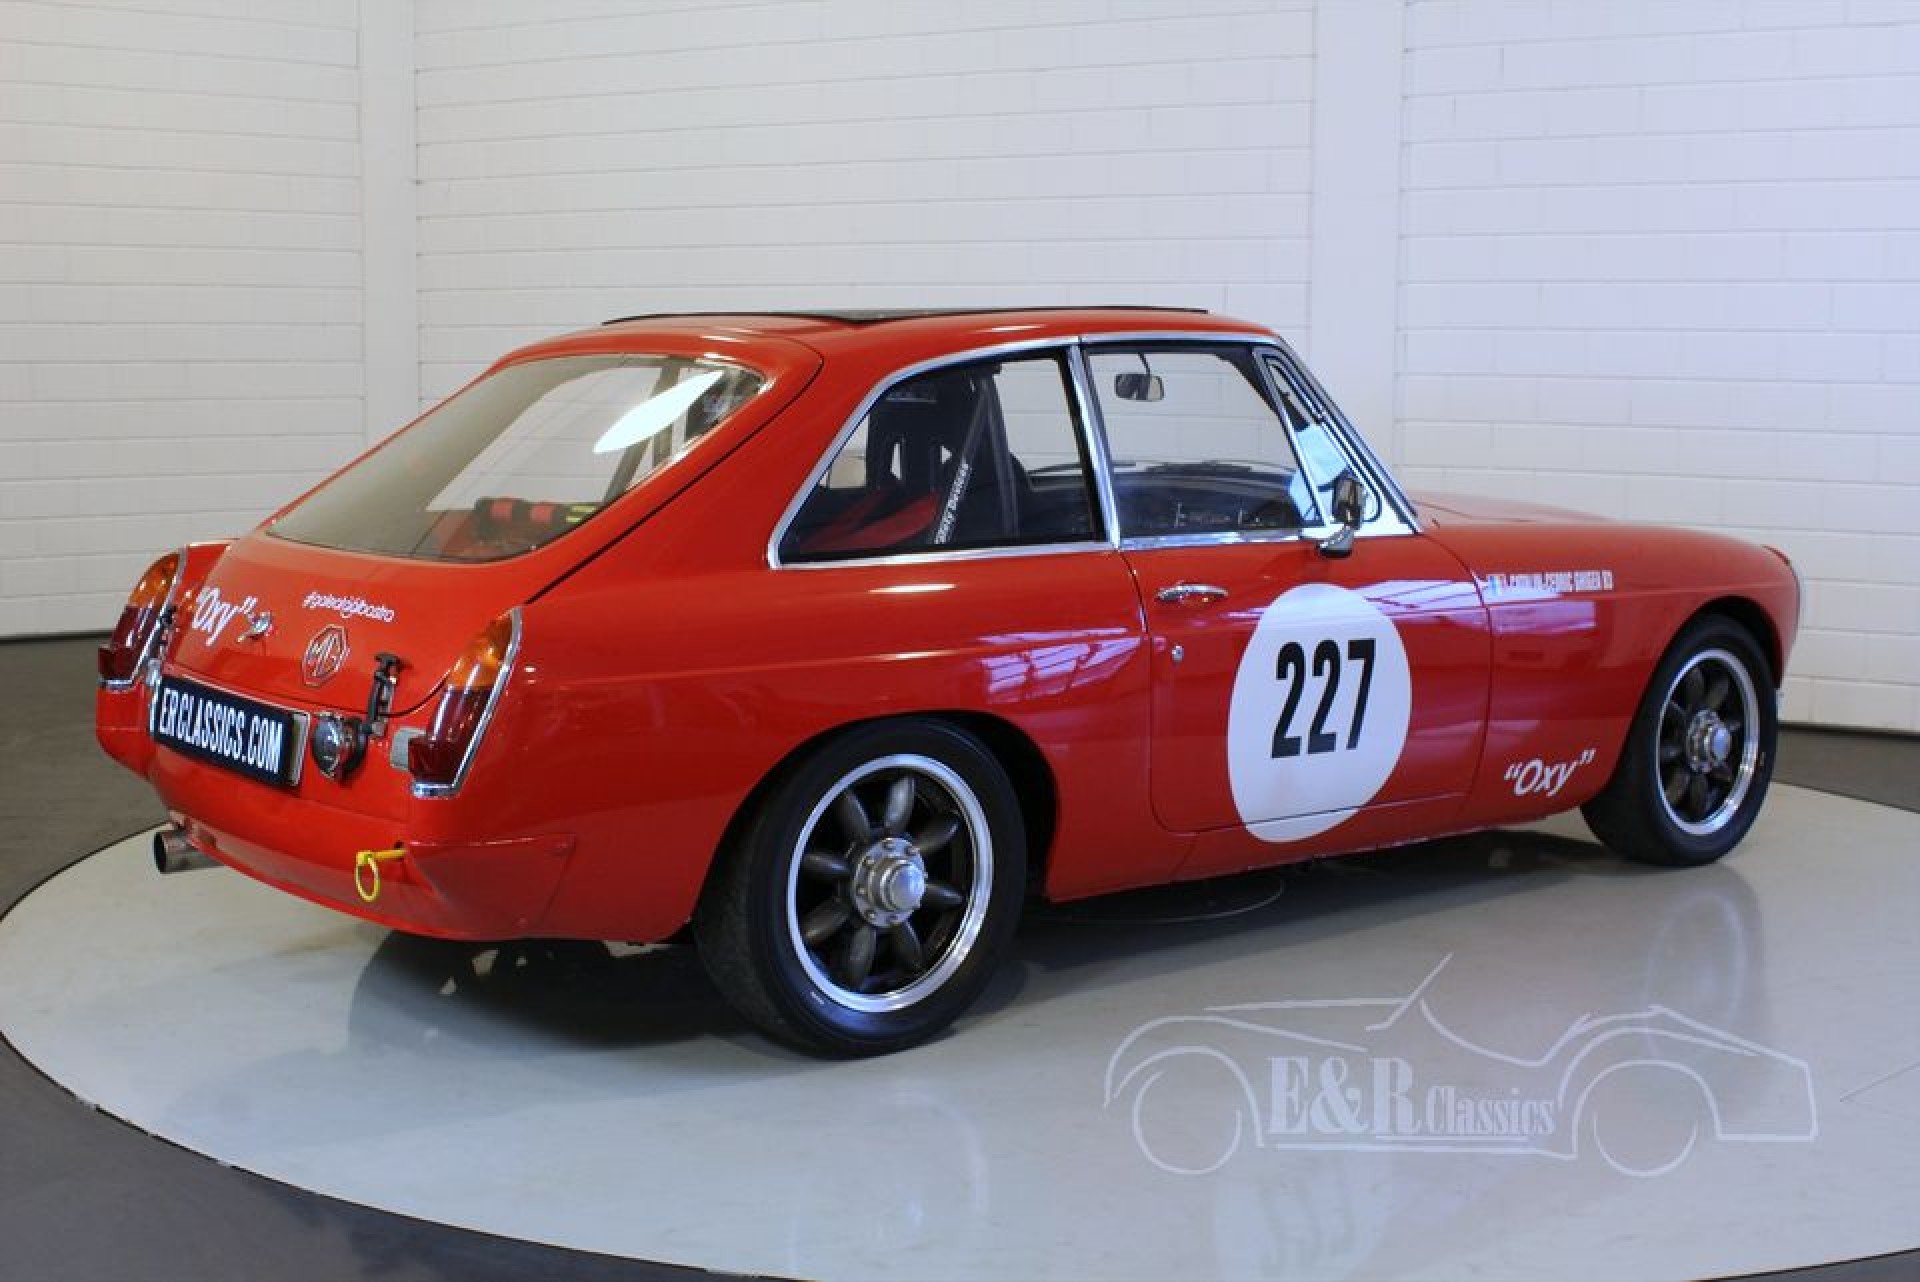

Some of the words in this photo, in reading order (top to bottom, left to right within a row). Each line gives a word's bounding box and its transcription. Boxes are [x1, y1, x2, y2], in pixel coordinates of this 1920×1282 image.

[307, 632, 343, 678] MG
[1271, 637, 1377, 759] 227
[158, 687, 283, 774] ERCLASSICS.COM
